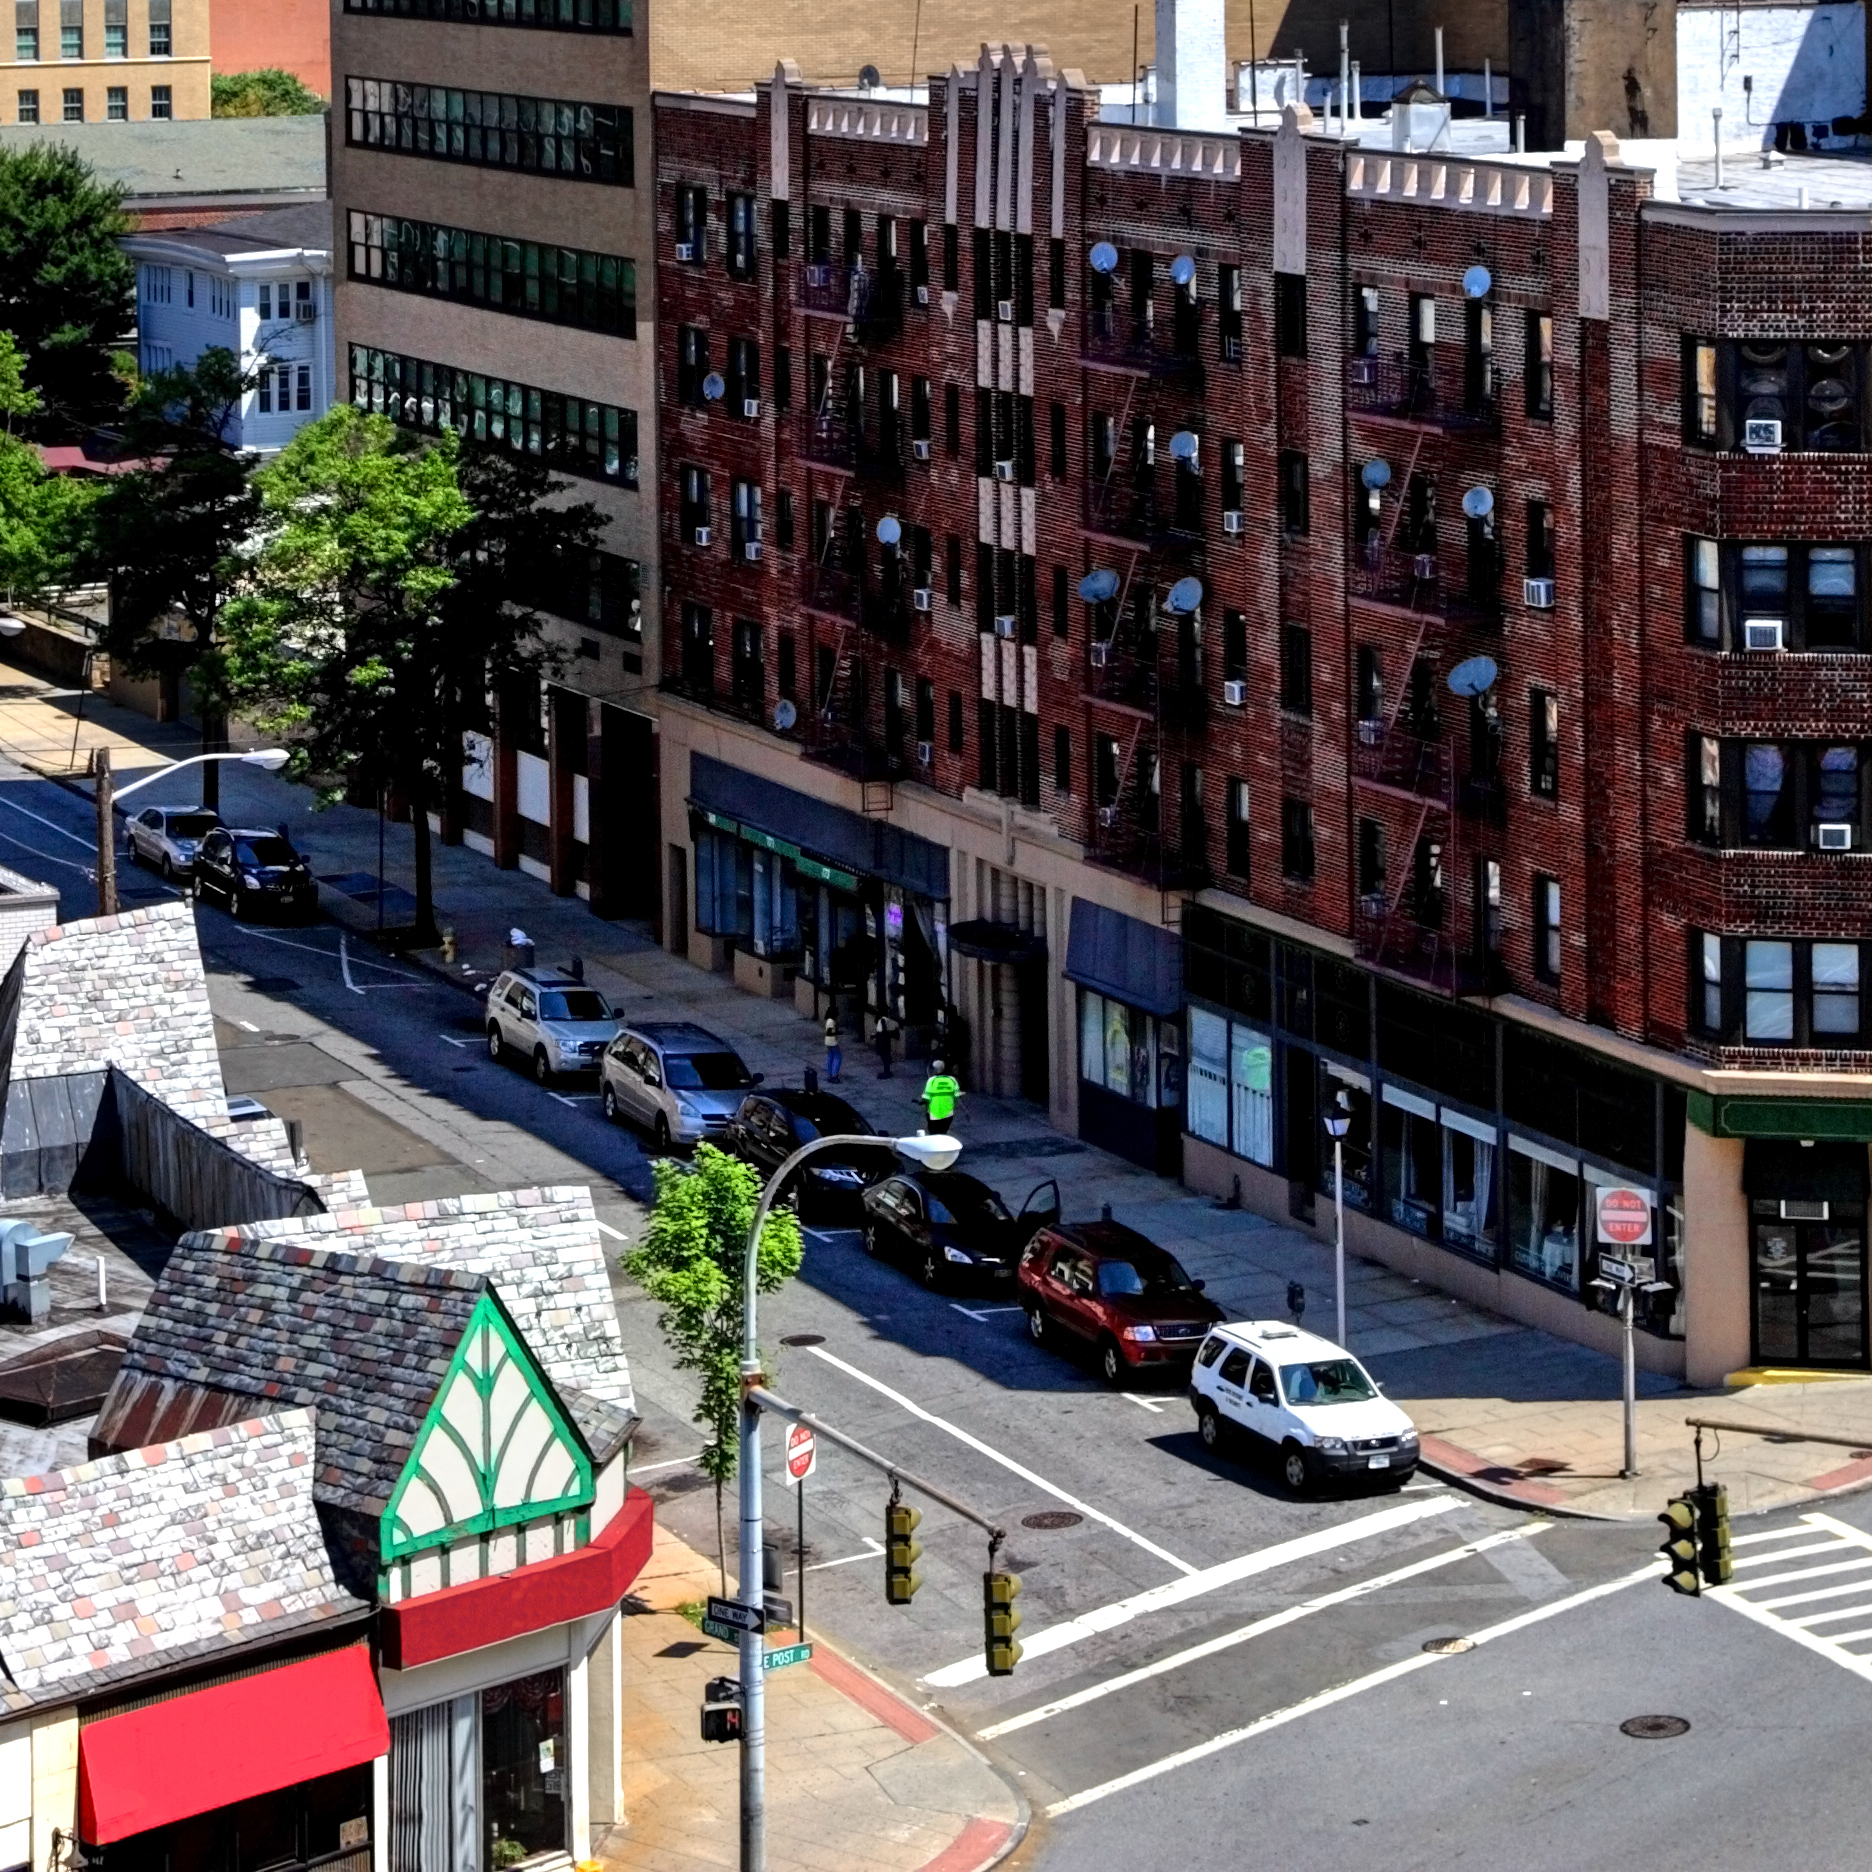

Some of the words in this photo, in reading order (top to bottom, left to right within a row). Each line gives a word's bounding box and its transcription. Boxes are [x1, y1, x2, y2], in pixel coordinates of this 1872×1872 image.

[1605, 1198, 1619, 1208] DO
[1623, 1199, 1641, 1209] NOT
[1609, 1222, 1640, 1233] ENTER
[714, 1605, 729, 1618] ONE
[732, 1609, 747, 1622] WAY
[704, 1620, 729, 1639] GRAND
[763, 1655, 770, 1669] E
[772, 1649, 795, 1667] POST
[801, 1649, 810, 1659] RD
